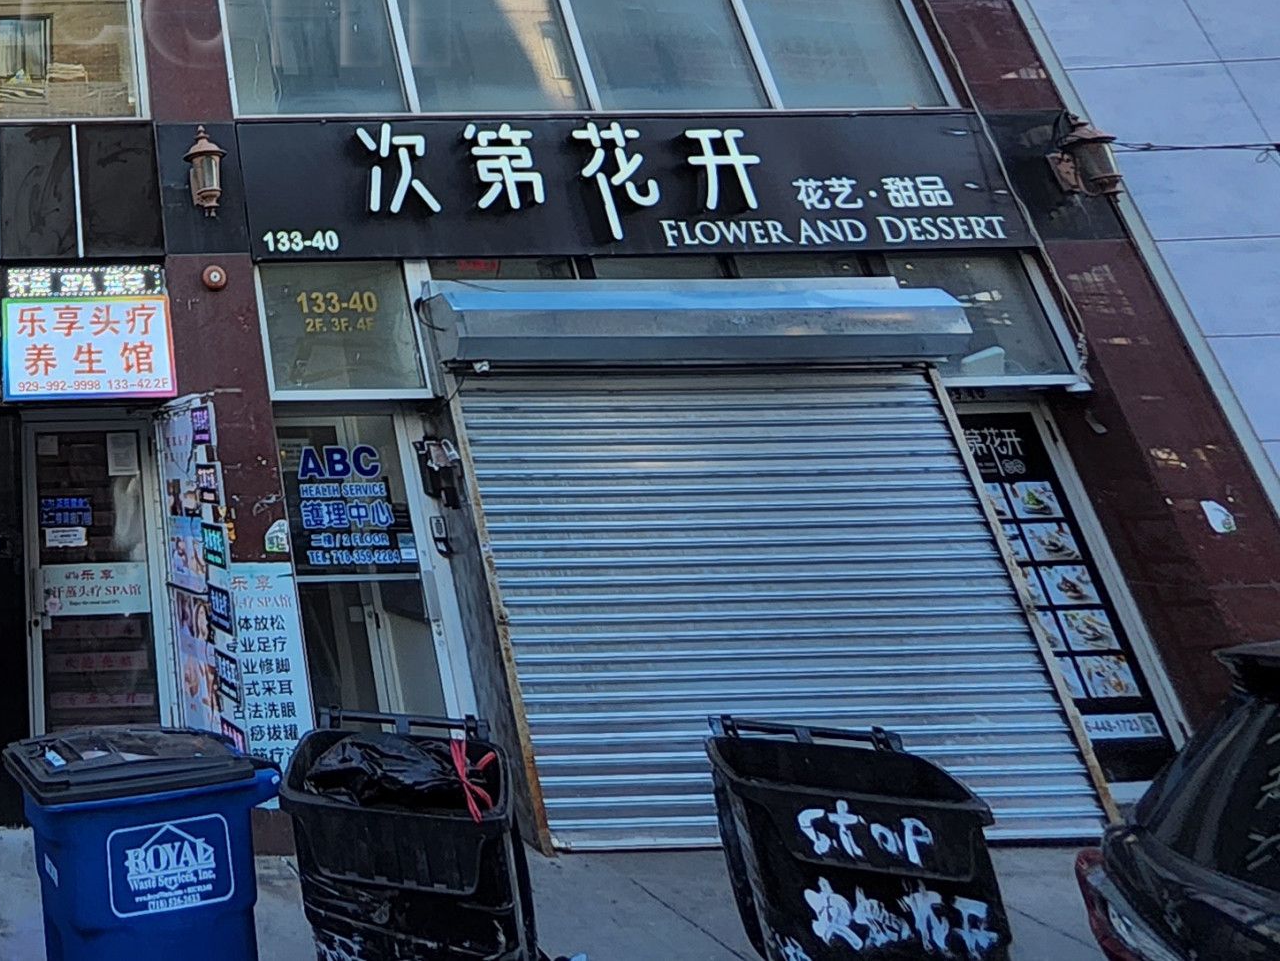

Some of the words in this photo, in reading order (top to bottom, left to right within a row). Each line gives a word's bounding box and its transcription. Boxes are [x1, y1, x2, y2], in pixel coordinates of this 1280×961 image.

[356, 122, 761, 240] 次第花开
[263, 230, 339, 251] 133-40
[660, 219, 793, 247] FLOWER
[799, 219, 867, 245] AND
[876, 216, 1012, 245] DESSERT
[60, 273, 96, 292] SPA
[297, 291, 377, 314] 133-40
[17, 304, 157, 338] 乐享头疗
[24, 341, 154, 377] 养生馆
[19, 381, 102, 392] 929-992-9998
[298, 445, 381, 479] ABC
[300, 484, 340, 498] HEALTH
[342, 483, 387, 497] SERVICE
[301, 500, 395, 529] 護理中心
[352, 533, 390, 546] FLOOR
[307, 550, 330, 564] TEL:
[331, 549, 401, 564] 718-359-2284
[231, 575, 273, 591] 乐享
[125, 838, 215, 875] ROYAL
[127, 876, 157, 892] Waste
[199, 869, 216, 881] Inc.
